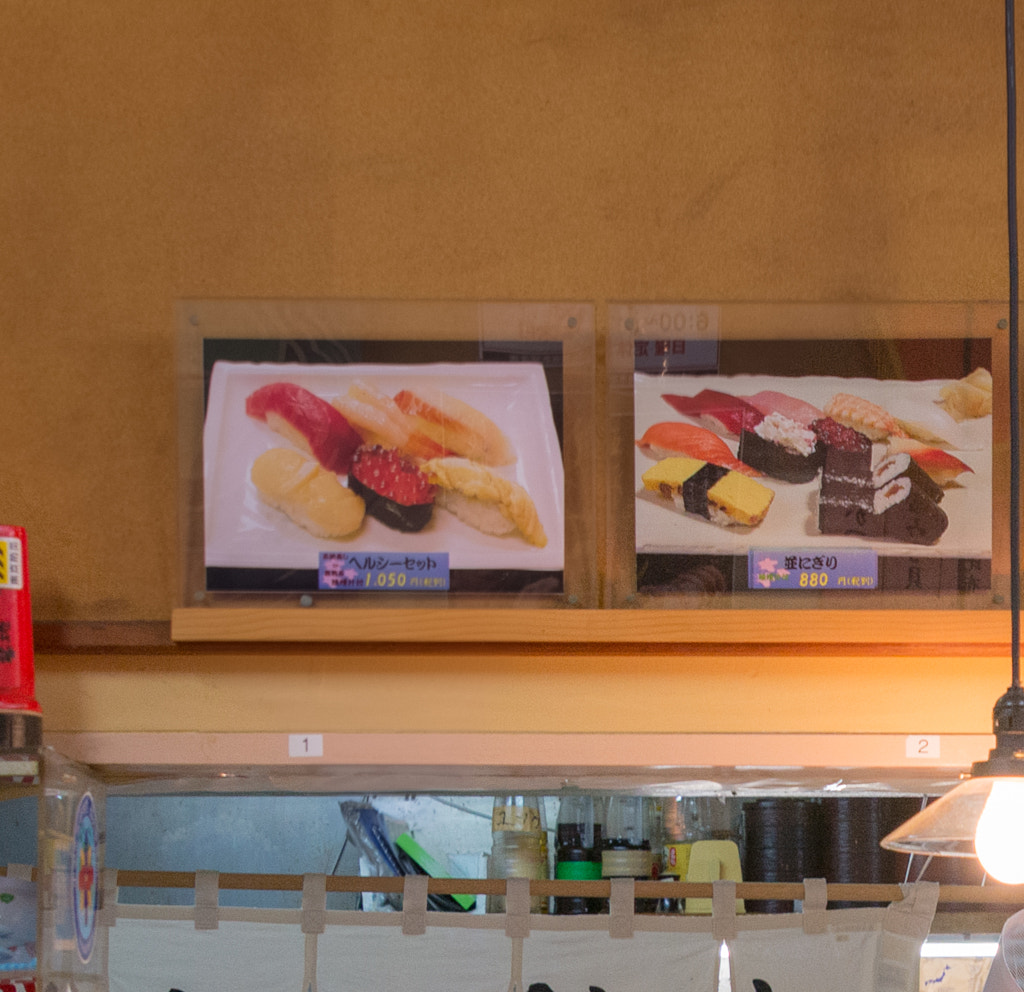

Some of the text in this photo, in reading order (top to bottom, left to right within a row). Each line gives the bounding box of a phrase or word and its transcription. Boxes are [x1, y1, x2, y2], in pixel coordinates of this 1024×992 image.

[348, 555, 438, 571] ヘルシーセット
[784, 555, 838, 571] 並にぎり
[799, 572, 829, 588] 880
[301, 738, 309, 752] 1
[918, 739, 930, 754] 2
